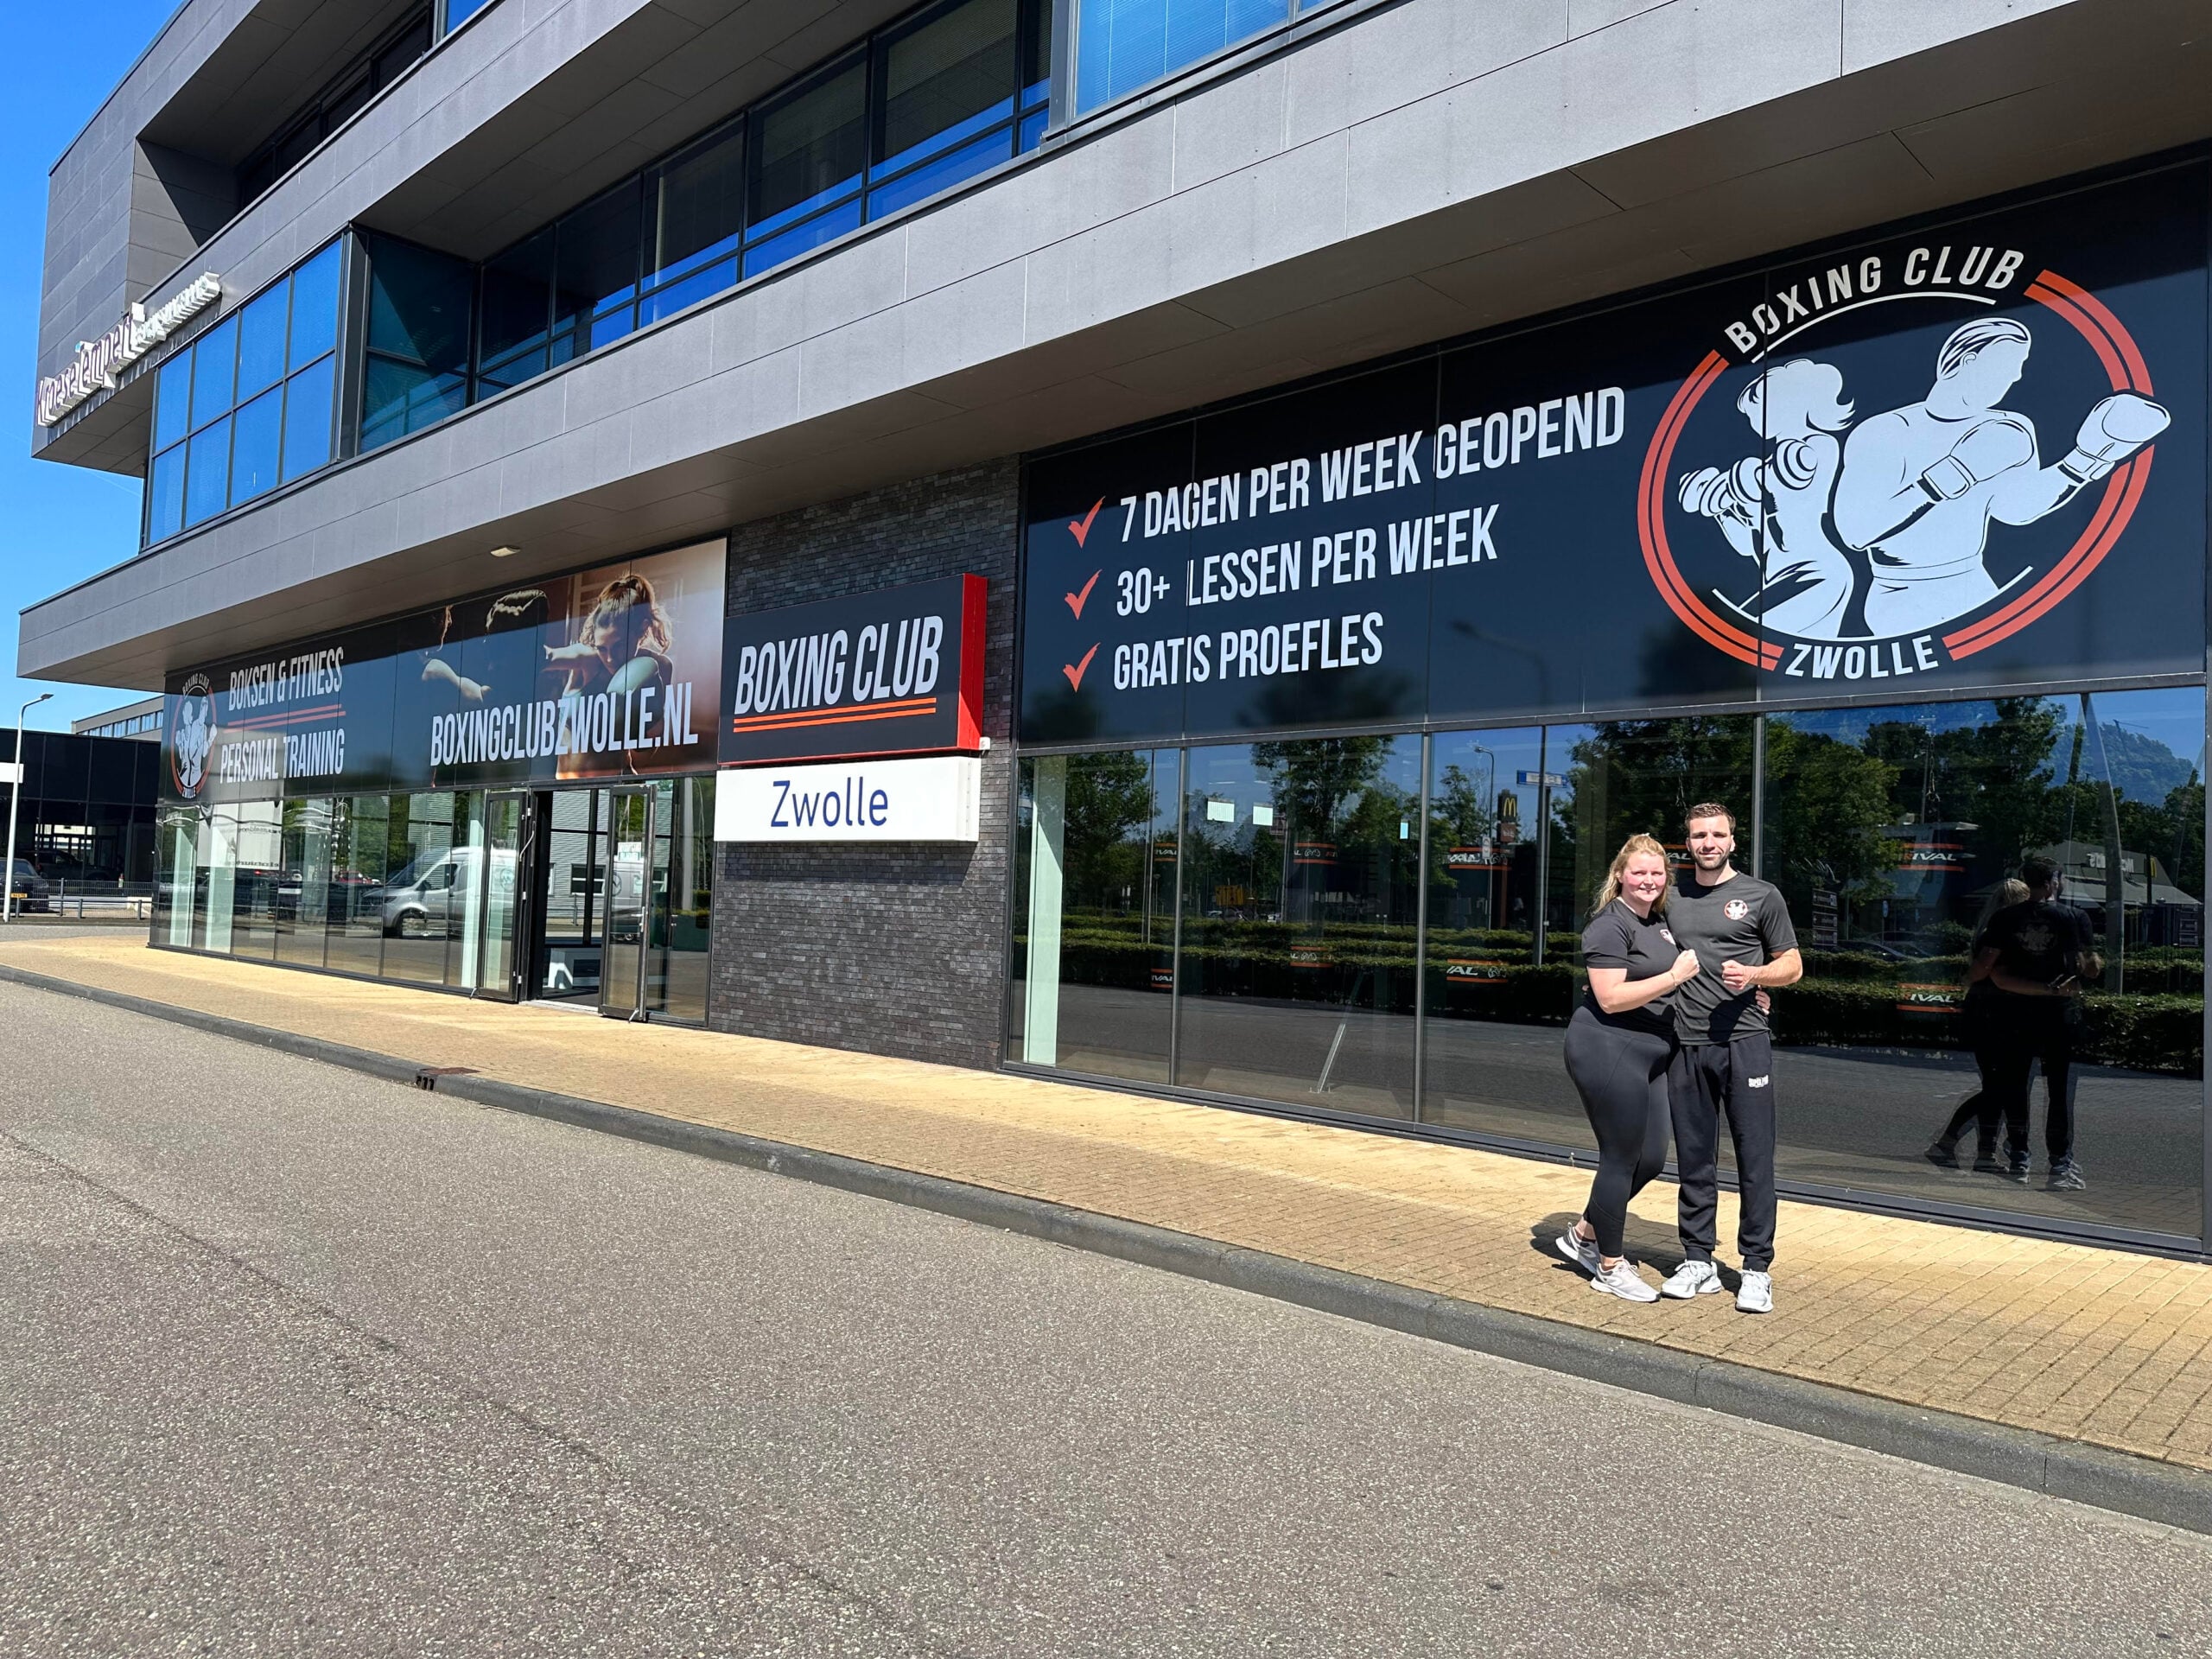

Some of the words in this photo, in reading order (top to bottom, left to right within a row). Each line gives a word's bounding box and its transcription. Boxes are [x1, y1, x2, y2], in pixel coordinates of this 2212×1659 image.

[1724, 256, 1882, 354] BOXING
[1904, 246, 2025, 289] CLUB
[1120, 495, 1139, 543] 7
[1144, 473, 1240, 539] DAGEN
[1249, 457, 1311, 518] PER
[1319, 430, 1423, 502] WEEK
[1433, 386, 1626, 480] GEOPEND
[1116, 567, 1171, 617] 30+
[1186, 540, 1300, 607] LESSEN
[1311, 526, 1377, 588] PER
[1388, 504, 1499, 575] WEEK
[228, 662, 276, 711] BOKSEN
[277, 660, 286, 701] &
[288, 646, 344, 701] FITNESS
[734, 629, 849, 714] BOXING
[852, 615, 944, 702] CLUB
[1113, 632, 1211, 690] GRATIS
[1218, 611, 1384, 680] PROEFLES
[1785, 633, 1940, 679] ZWOLLE
[219, 737, 278, 784] PERSONAL
[283, 728, 346, 779] TRAINING
[430, 682, 698, 766] BOXINGCLUBZWOLLE.NL
[771, 776, 888, 827] Zwolle
